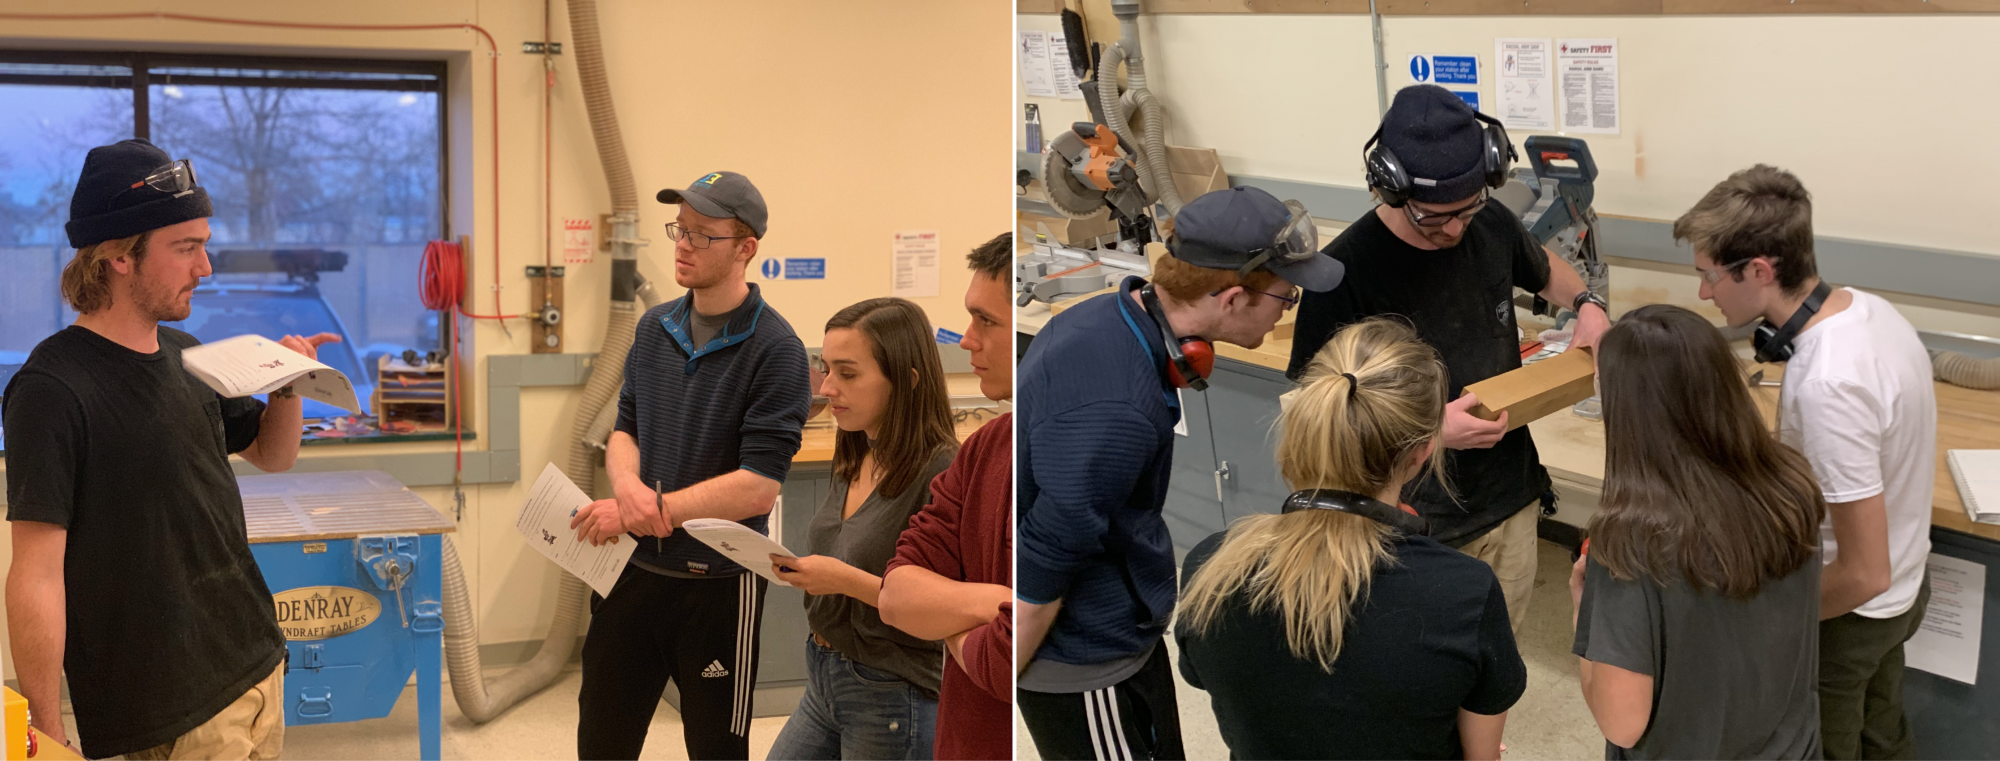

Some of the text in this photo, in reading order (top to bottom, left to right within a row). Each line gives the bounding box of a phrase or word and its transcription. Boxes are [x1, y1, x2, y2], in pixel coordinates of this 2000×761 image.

[1590, 45, 1613, 54] FIRST
[277, 596, 354, 623] DENRAY
[330, 614, 367, 634] TABLES
[701, 669, 729, 678] adidas
